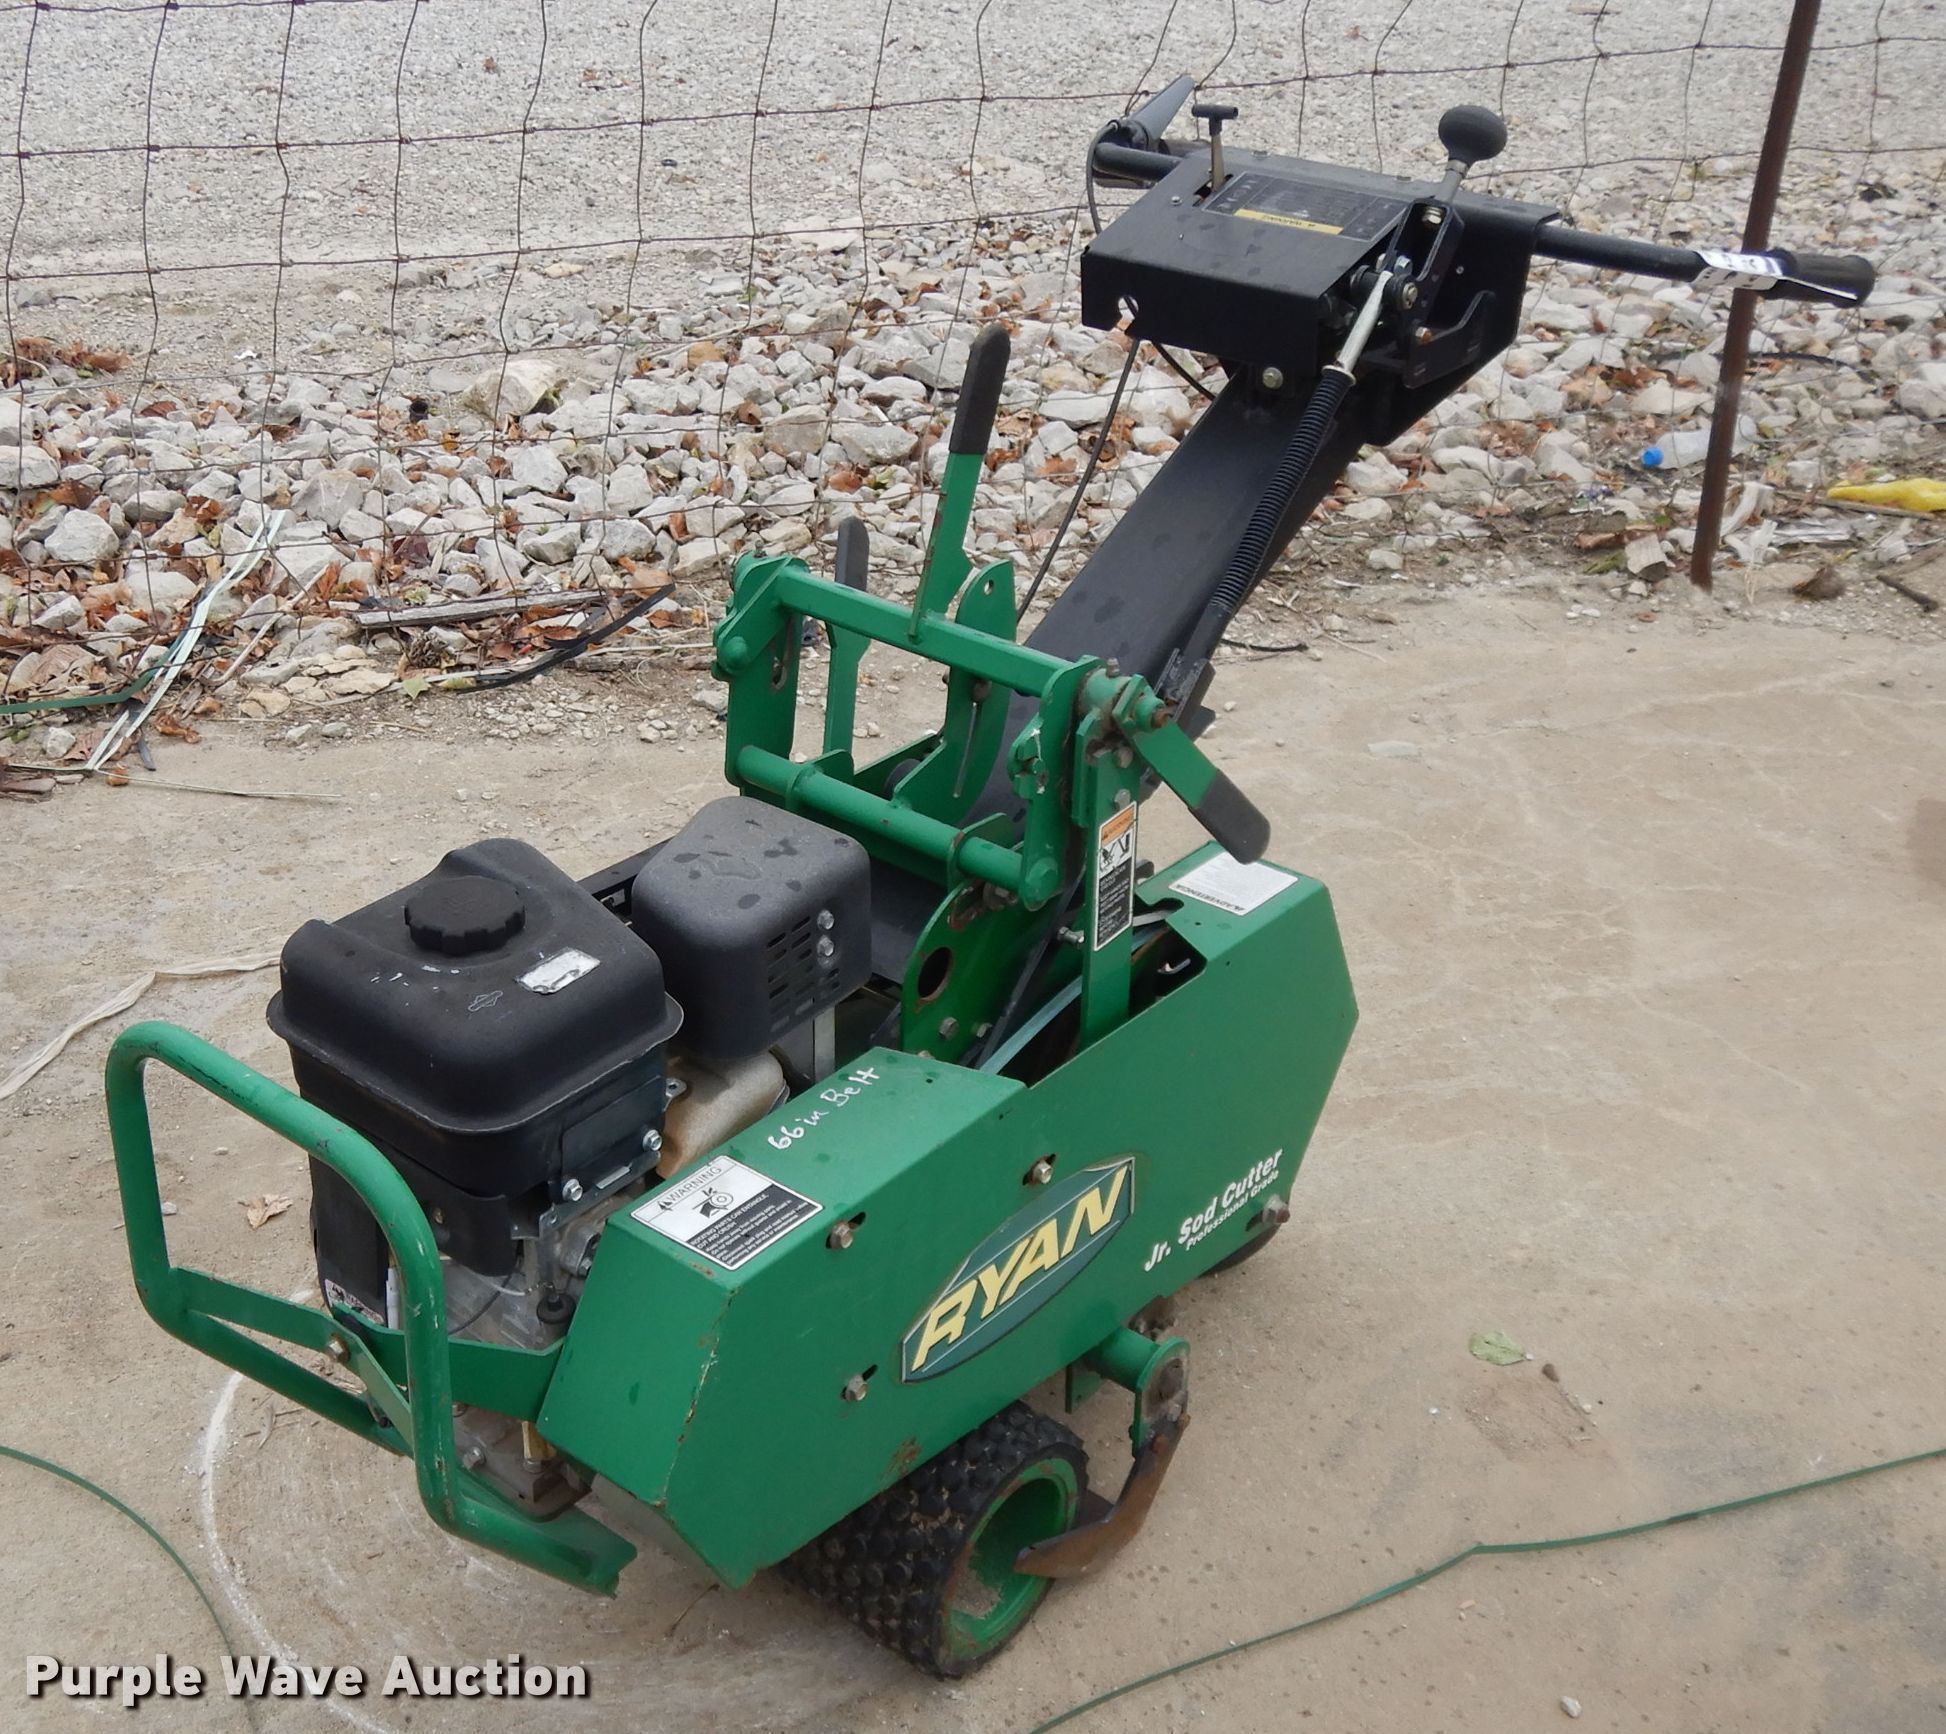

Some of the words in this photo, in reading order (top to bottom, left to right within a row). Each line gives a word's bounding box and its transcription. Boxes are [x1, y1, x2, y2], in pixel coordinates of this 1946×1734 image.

[768, 1125, 804, 1150] 66
[820, 1067, 880, 1107] Belt
[668, 1165, 722, 1202] WARNING
[1144, 1241, 1171, 1272] Jr.
[1178, 1197, 1218, 1244] Sod
[1221, 1148, 1283, 1209] Cutter
[1186, 1193, 1248, 1251] Professional
[911, 1165, 1128, 1372] RYAN
